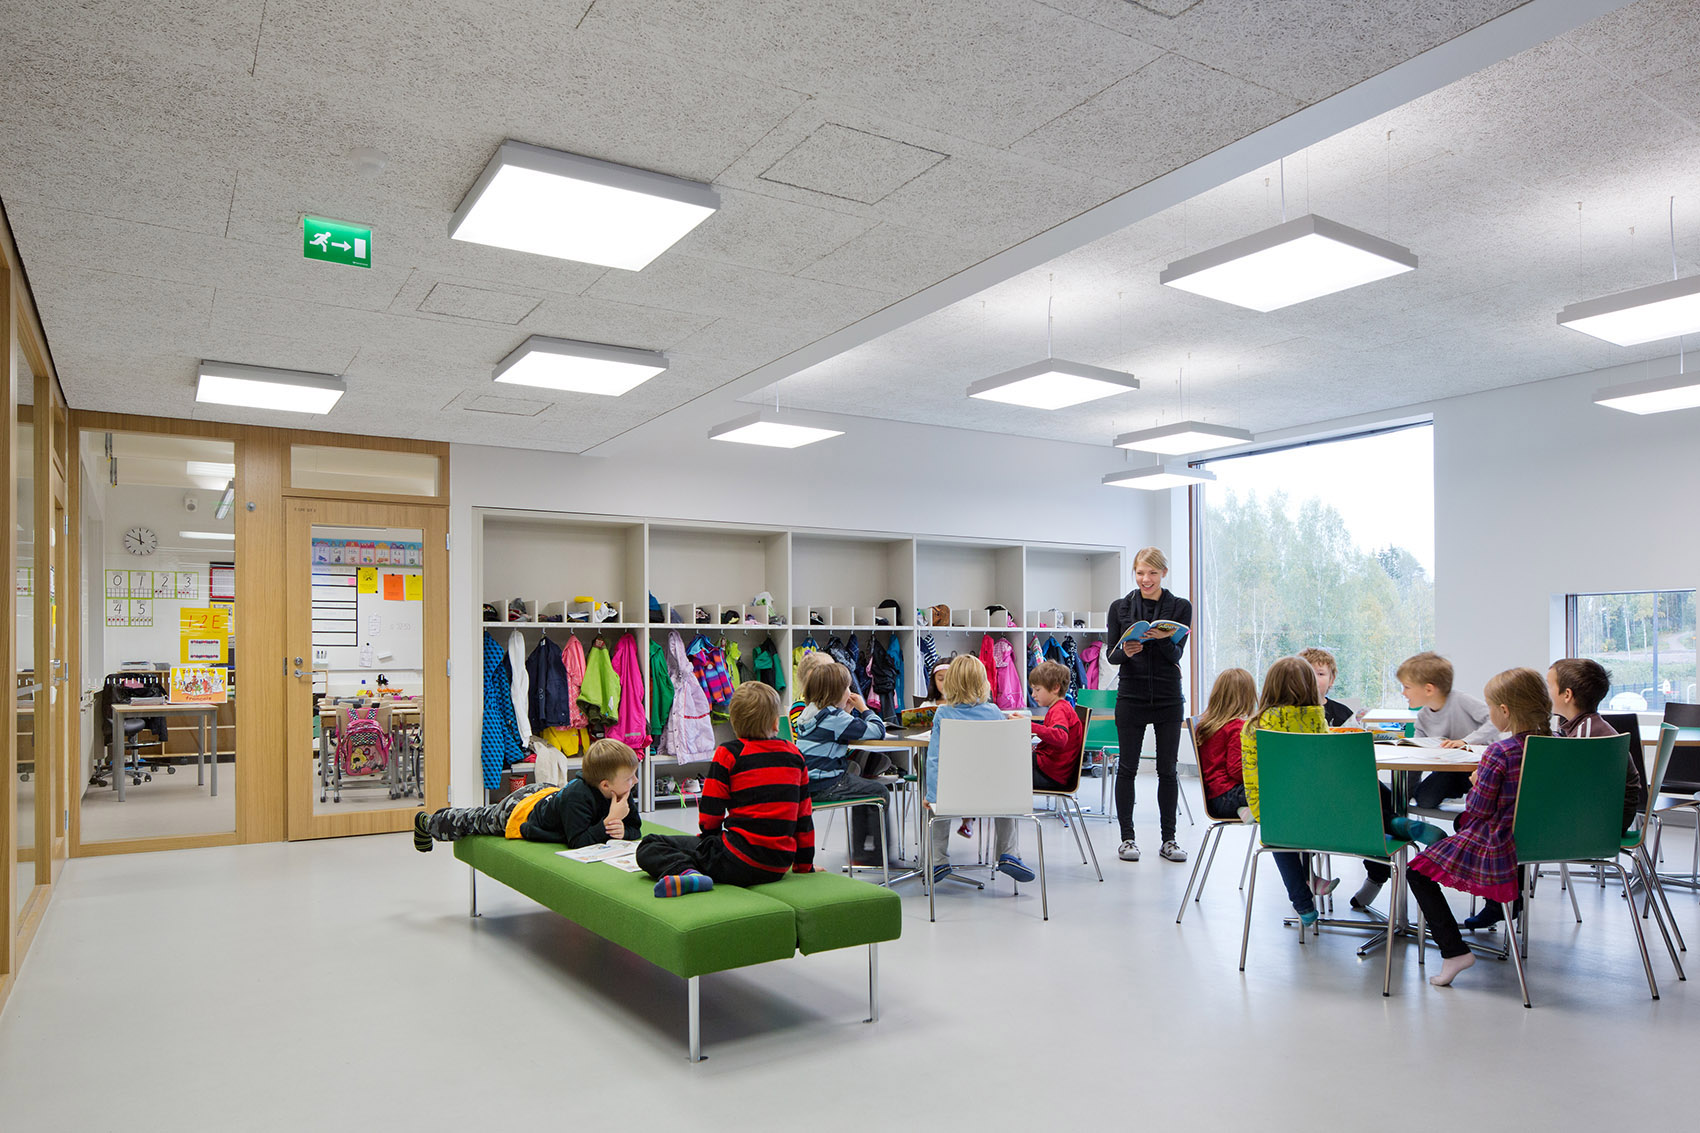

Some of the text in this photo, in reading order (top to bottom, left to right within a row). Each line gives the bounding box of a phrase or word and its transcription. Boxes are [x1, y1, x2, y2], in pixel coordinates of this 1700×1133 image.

[113, 574, 122, 586] 0
[139, 575, 143, 587] 1
[161, 575, 169, 588] 2
[184, 576, 191, 588] 3
[113, 603, 122, 614] 4
[138, 603, 146, 615] 5
